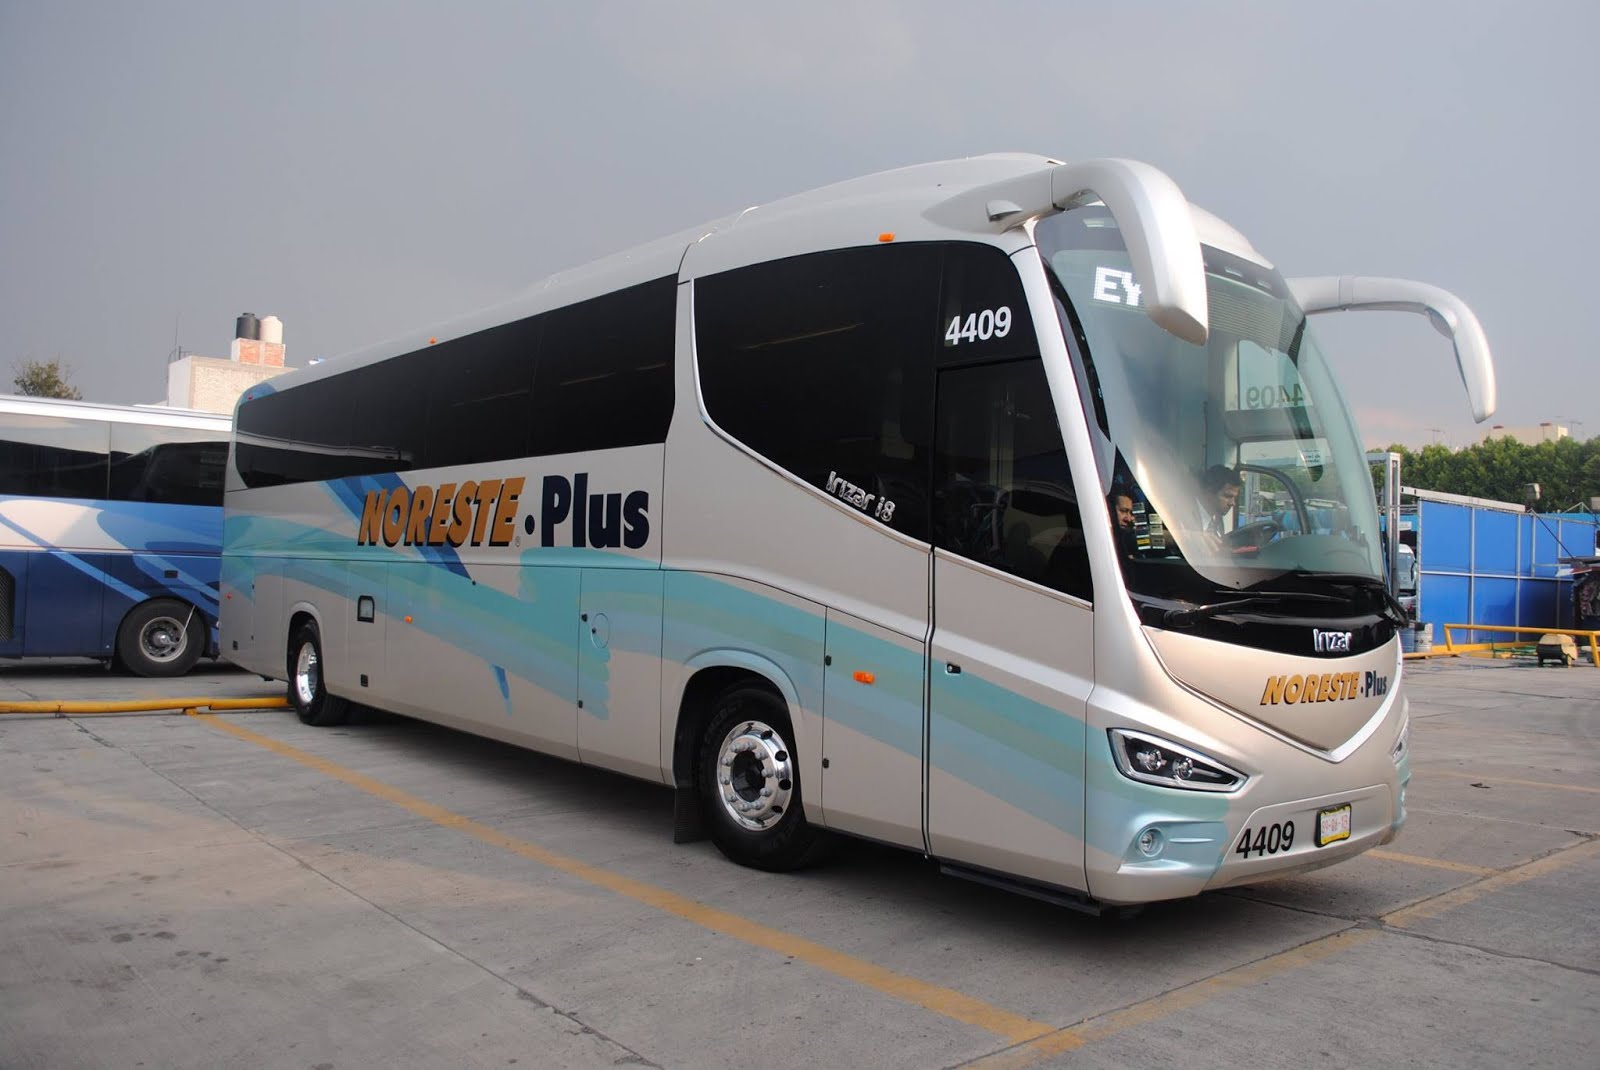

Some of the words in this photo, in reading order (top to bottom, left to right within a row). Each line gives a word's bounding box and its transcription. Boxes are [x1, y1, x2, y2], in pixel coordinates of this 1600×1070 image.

[945, 306, 1012, 346] 4409
[357, 477, 525, 547] NORESTE
[541, 473, 650, 549] Plus
[826, 471, 875, 510] Irizar
[875, 496, 896, 522] i8
[1260, 671, 1360, 705] NORESTE
[1236, 820, 1295, 859] 4409
